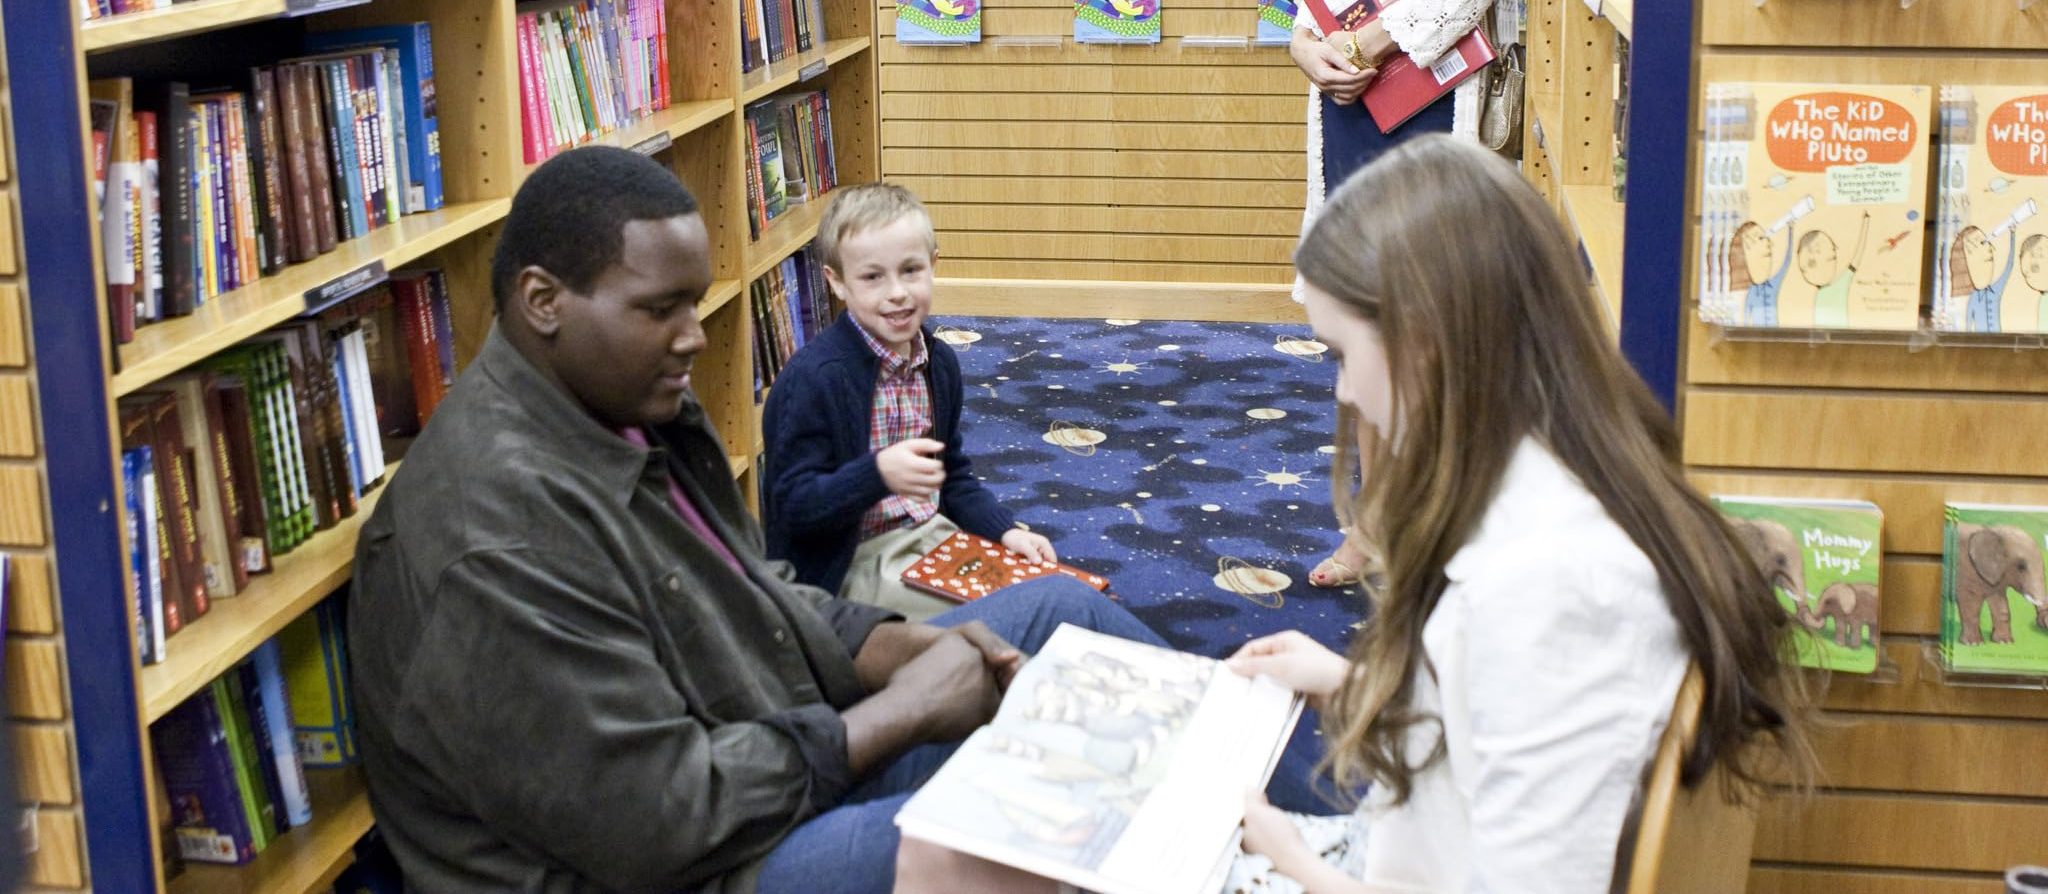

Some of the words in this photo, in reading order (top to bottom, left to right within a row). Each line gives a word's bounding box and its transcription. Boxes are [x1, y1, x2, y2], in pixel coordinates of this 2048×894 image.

[1792, 98, 1841, 121] The
[1847, 100, 1885, 121] KiD
[1831, 121, 1910, 142] Named
[1802, 528, 1872, 556] Mommy
[1814, 549, 1861, 576] Hugs
